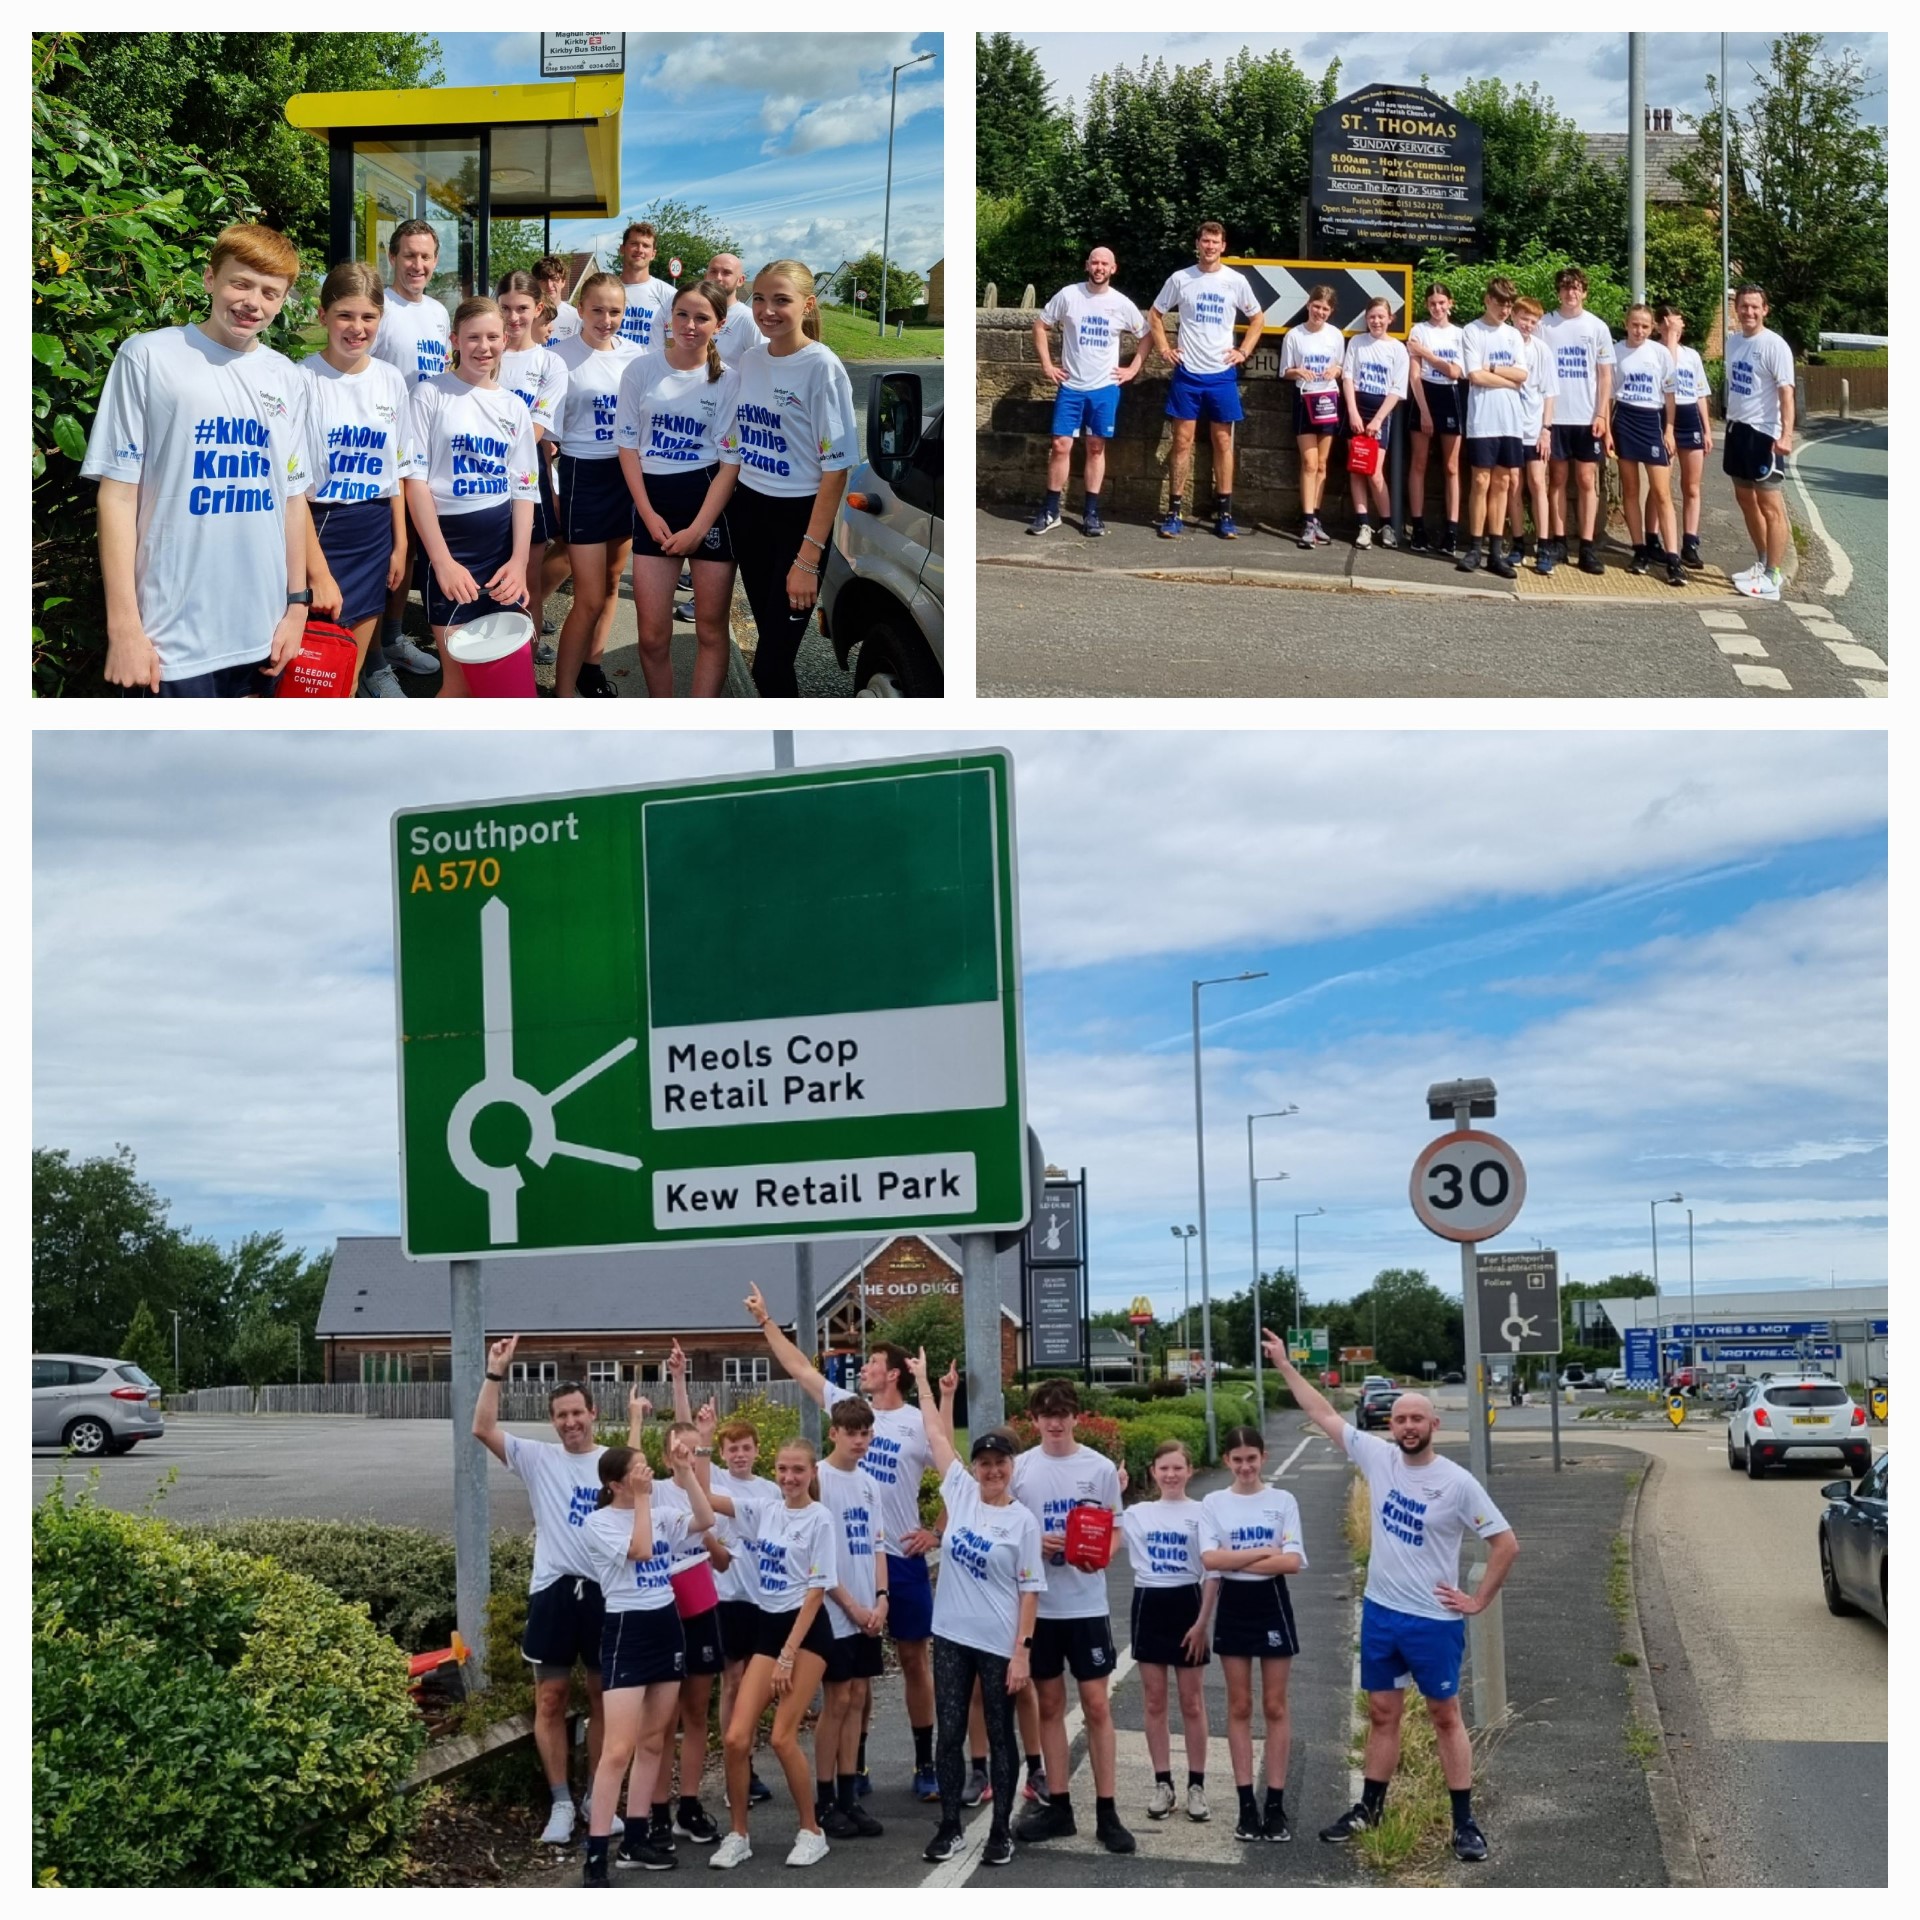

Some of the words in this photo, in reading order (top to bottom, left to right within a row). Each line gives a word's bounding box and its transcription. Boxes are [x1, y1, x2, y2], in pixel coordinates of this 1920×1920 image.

[565, 38, 587, 46] Kirkby
[1341, 114, 1368, 131] ST.
[1376, 117, 1456, 138] THOMAS
[1352, 139, 1396, 151] SUNDAY
[1398, 142, 1446, 155] SERVICES
[1331, 154, 1368, 164] 8.00am
[1380, 157, 1403, 168] Holy
[1405, 160, 1466, 173] Communion
[1332, 164, 1371, 175] 11.00am
[1382, 168, 1414, 178] Parish
[1417, 171, 1464, 182] Eucharist
[1332, 180, 1362, 190] Rector:
[1364, 182, 1380, 191] The
[1408, 186, 1420, 194] Dr.
[1422, 188, 1446, 196] Susan
[1448, 189, 1464, 198] Salt
[1352, 197, 1371, 205] Parish
[1372, 198, 1394, 207] Office:
[1397, 200, 1411, 208] 0151
[1413, 201, 1425, 209] 526
[1427, 202, 1444, 210] 2292
[1322, 204, 1340, 213] Open
[1404, 210, 1429, 220] Tuesday
[1437, 213, 1473, 223] Wednesday
[1357, 229, 1368, 237] We
[1370, 230, 1391, 238] would
[1392, 231, 1407, 239] love
[1417, 233, 1429, 242] get
[1439, 234, 1457, 242] know
[672, 264, 680, 272] 20
[625, 306, 653, 319] kNOw
[1196, 303, 1223, 313] Knife
[1196, 314, 1222, 324] Crime
[1081, 325, 1109, 336] Knife
[1079, 336, 1108, 347] Crime
[1558, 357, 1587, 367] Knife
[1558, 369, 1588, 378] Crime
[1624, 384, 1652, 393] Knife
[737, 404, 781, 429] #kNOw
[328, 425, 387, 450] #kNOw
[739, 425, 787, 453] Knife
[452, 434, 508, 458] #kNOw
[193, 450, 270, 479] Knife
[453, 455, 506, 477] Knife
[739, 447, 790, 476] Crime
[453, 477, 508, 497] Crime
[189, 484, 274, 515] Crime
[295, 666, 336, 679] BLEEDING
[294, 676, 333, 687] CONTROL
[411, 812, 579, 855] Southport
[667, 1040, 772, 1073] Meols
[787, 1035, 858, 1068] Cop
[664, 1078, 769, 1113] Retail
[783, 1072, 865, 1104] Park
[666, 1182, 740, 1213] Kew
[756, 1174, 862, 1208] Retail
[878, 1167, 961, 1201] Park
[1428, 1160, 1509, 1210] 30
[1483, 1256, 1498, 1264] For
[1501, 1255, 1544, 1264] Southport
[857, 1284, 884, 1295] THE
[888, 1283, 918, 1295] OLD
[921, 1283, 959, 1294] DUKE
[1699, 1326, 1743, 1334] TYRES
[1747, 1326, 1756, 1334] &
[1760, 1325, 1791, 1333] MOT
[1382, 1501, 1424, 1531] Knife
[1146, 1531, 1188, 1545] #kNOw
[1230, 1526, 1274, 1540] #kNOw
[1147, 1545, 1188, 1561] Knife
